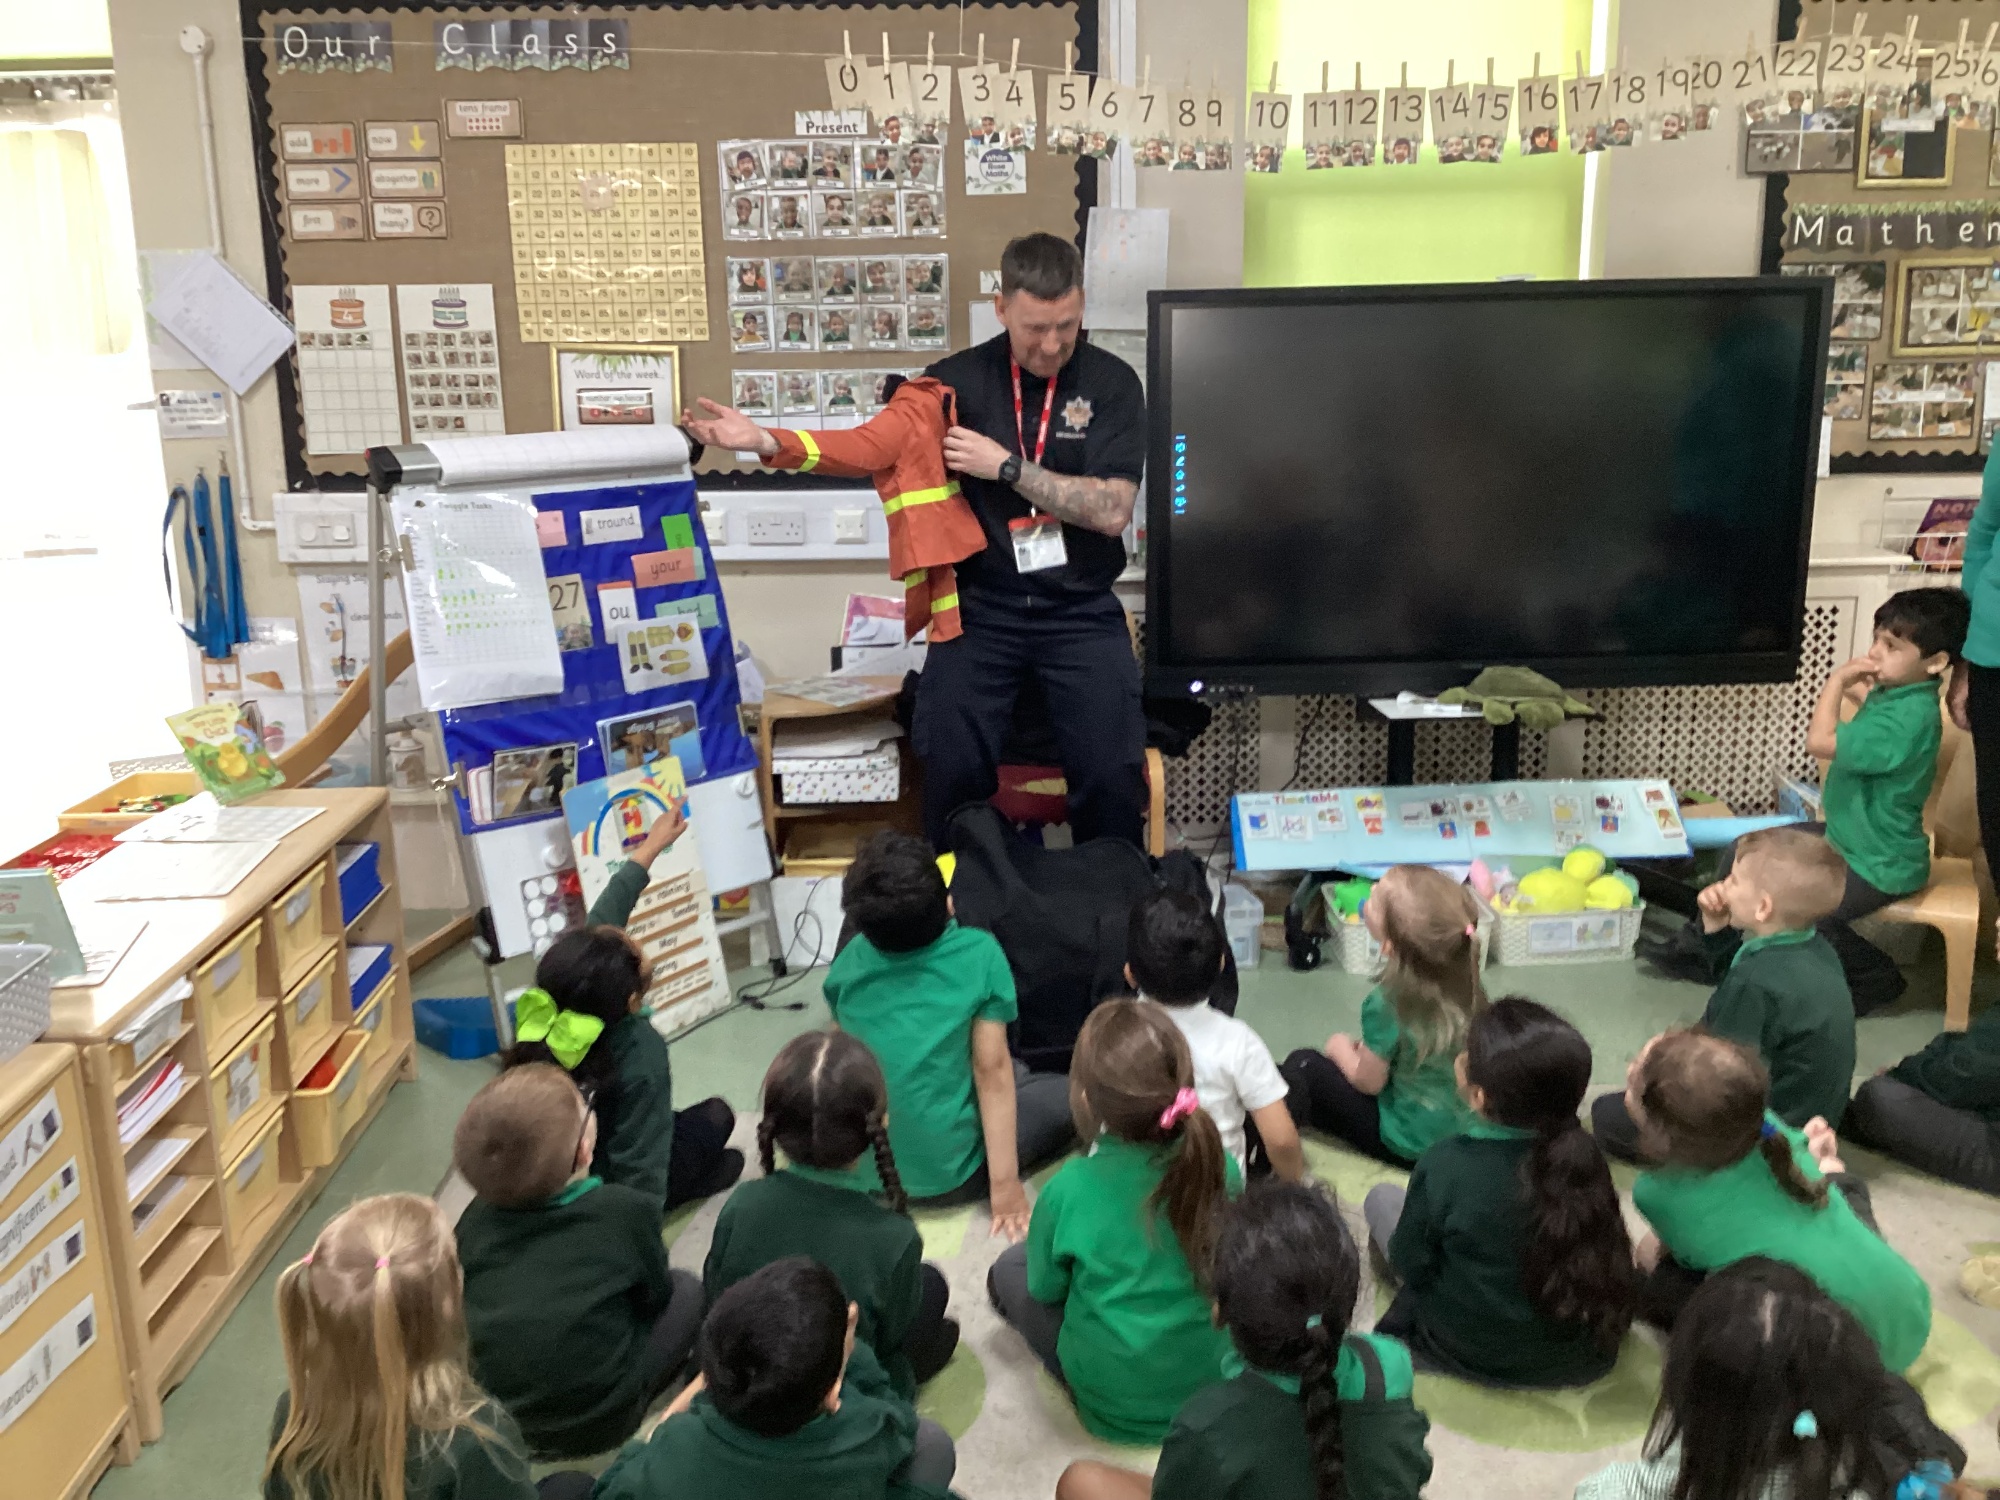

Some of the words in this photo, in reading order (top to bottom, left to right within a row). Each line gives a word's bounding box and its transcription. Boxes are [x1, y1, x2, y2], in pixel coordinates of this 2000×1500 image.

[283, 26, 380, 58] Our
[442, 23, 617, 55] Class
[840, 65, 858, 92] 0
[883, 74, 895, 100] 1
[922, 74, 939, 102] 2
[972, 74, 991, 102] 3
[1005, 79, 1022, 107] 4
[1060, 83, 1076, 111] 5
[1103, 91, 1118, 118] 6
[1138, 95, 1155, 123] 7
[1179, 99, 1196, 127] 8
[1207, 99, 1222, 127] 9
[1256, 101, 1288, 129] 10
[1309, 100, 1339, 127] 11
[1344, 97, 1377, 125] 12
[1390, 95, 1423, 122] 13
[1435, 92, 1470, 122] 14
[1476, 92, 1509, 121] 15
[1524, 84, 1558, 112] 16
[1569, 83, 1602, 112] 17
[1613, 76, 1646, 103] 18
[1657, 69, 1689, 96] 19
[1733, 56, 1767, 88] 21
[1778, 50, 1816, 76] 22
[1828, 44, 1866, 72] 23
[1878, 42, 1914, 70] 24
[1935, 52, 1971, 79] 25
[806, 121, 858, 134] Present
[985, 154, 1008, 162] White
[531, 170, 540, 179] 12
[550, 170, 559, 178] 13
[684, 169, 694, 177] 20
[513, 190, 521, 198] 21
[531, 189, 542, 198] 22
[551, 189, 561, 197] 23
[570, 189, 580, 197] 24
[627, 188, 638, 197] 27
[647, 188, 658, 196] 28
[666, 188, 677, 196] 29
[685, 188, 696, 196] 30
[515, 210, 523, 218] 31
[533, 210, 543, 218] 32
[552, 209, 563, 218] 33
[572, 209, 581, 217] 34
[610, 209, 620, 217] 36
[629, 208, 639, 217] 37
[649, 209, 659, 217] 38
[668, 208, 678, 216] 39
[686, 208, 697, 216] 40
[534, 230, 545, 238] 42
[553, 230, 564, 238] 43
[592, 229, 602, 238] 45
[630, 229, 640, 237] 47
[650, 229, 660, 237] 48
[669, 229, 679, 237] 49
[688, 229, 698, 237] 50
[517, 250, 526, 258] 51
[535, 250, 546, 258] 52
[555, 249, 565, 258] 53
[594, 249, 605, 257] 55
[613, 249, 623, 257] 56
[631, 249, 642, 257] 57
[651, 249, 661, 257] 58
[670, 248, 681, 257] 59
[689, 249, 700, 257] 60
[556, 270, 567, 278] 63
[653, 269, 664, 278] 68
[671, 269, 682, 277] 69
[690, 268, 701, 277] 70
[521, 289, 530, 297] 71
[540, 289, 550, 297] 72
[559, 289, 569, 297] 73
[598, 289, 608, 297] 75
[617, 288, 627, 297] 76
[635, 288, 645, 296] 77
[654, 288, 664, 296] 78
[674, 288, 684, 296] 79
[541, 309, 552, 317] 82
[560, 309, 571, 317] 83
[580, 309, 590, 317] 84
[598, 309, 609, 317] 85
[618, 308, 629, 317] 86
[636, 308, 647, 317] 87
[655, 308, 666, 316] 88
[674, 308, 685, 316] 89
[693, 308, 704, 316] 90
[543, 328, 553, 336] 92
[619, 327, 630, 335] 96
[637, 327, 648, 335] 97
[657, 327, 667, 335] 98
[694, 327, 706, 335] 100
[574, 369, 600, 379] Word
[604, 369, 613, 382] of
[616, 369, 632, 379] the
[650, 559, 681, 580] your
[550, 582, 579, 611] 27
[609, 605, 630, 620] ou
[659, 935, 678, 949] May
